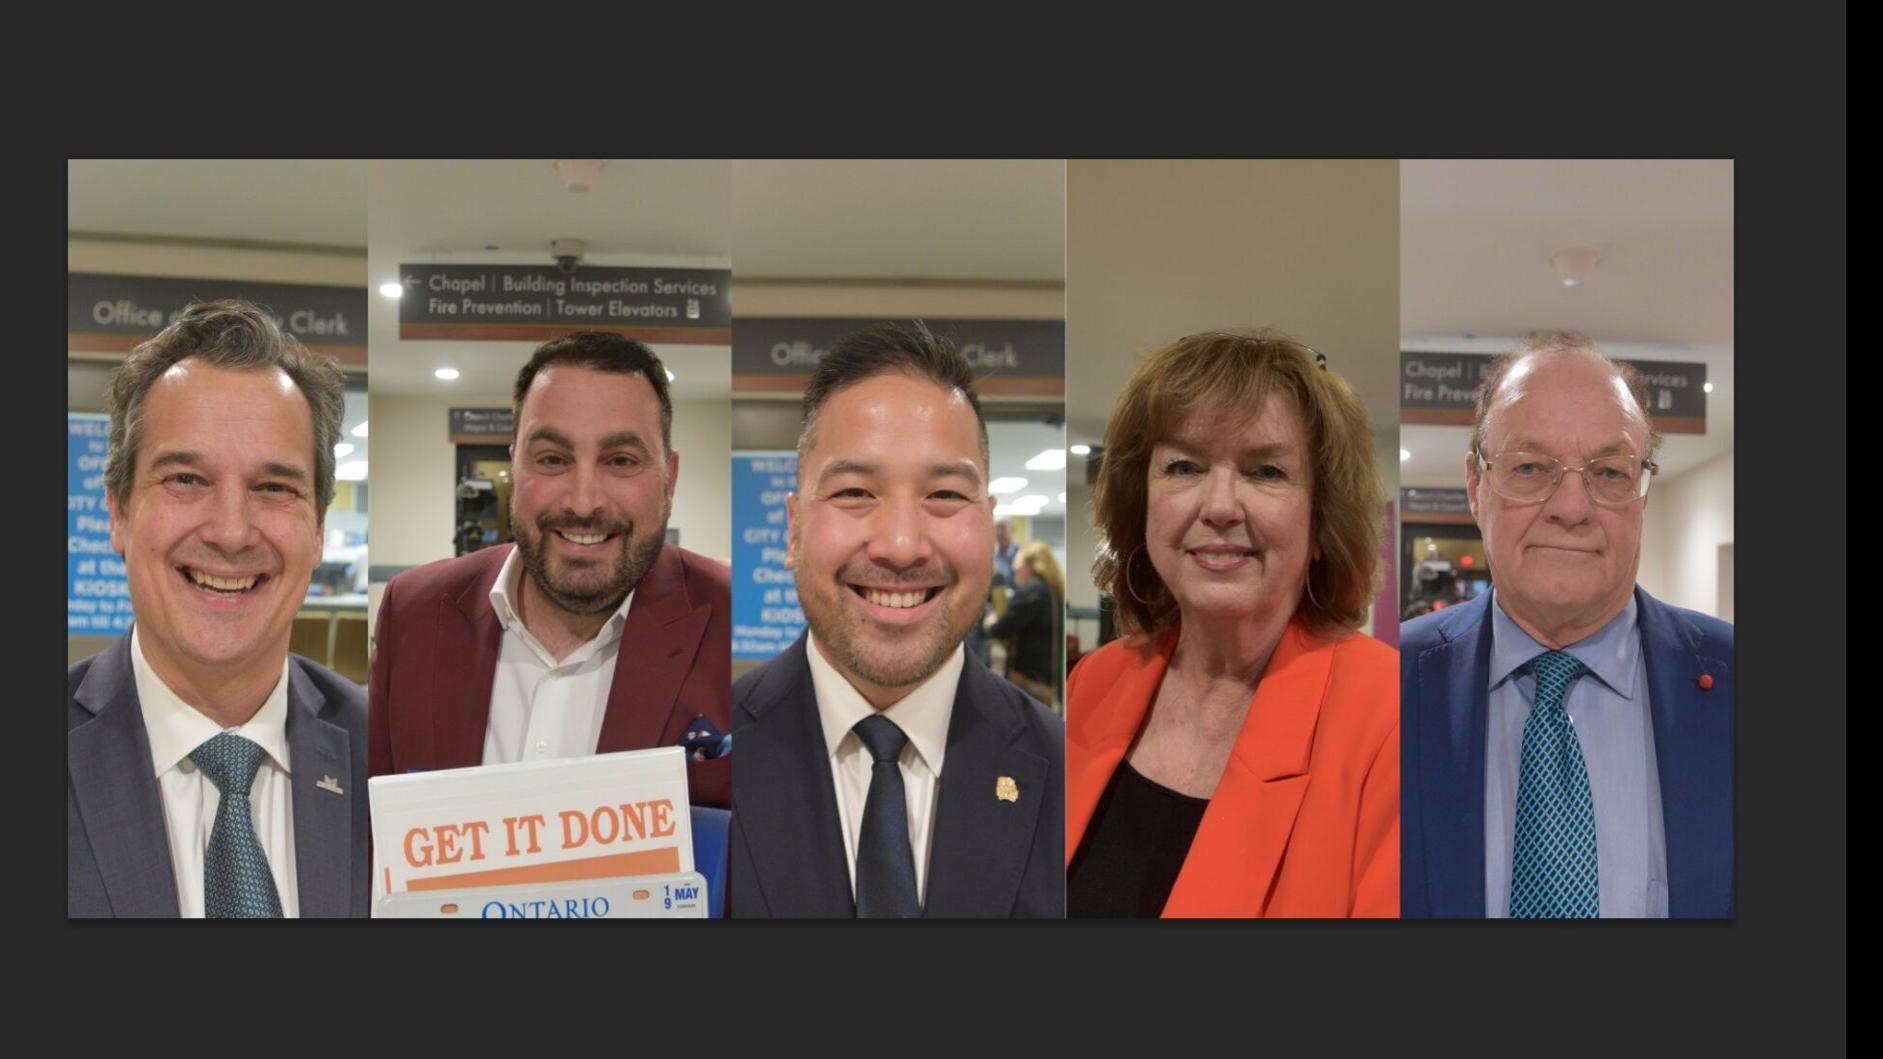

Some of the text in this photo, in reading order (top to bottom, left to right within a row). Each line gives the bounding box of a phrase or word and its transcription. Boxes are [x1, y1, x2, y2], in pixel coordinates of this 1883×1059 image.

[428, 274, 717, 296] Chapel Building Inspection Services
[92, 299, 163, 327] Office
[290, 309, 349, 336] Clerk
[428, 298, 679, 318] Fire Prevention Tower Elevators
[1405, 360, 1462, 381] Chapel
[1405, 383, 1434, 401] Fire
[403, 798, 677, 868] GET IT DONE
[674, 886, 699, 900] MAY
[481, 896, 610, 918] ONTARIO
